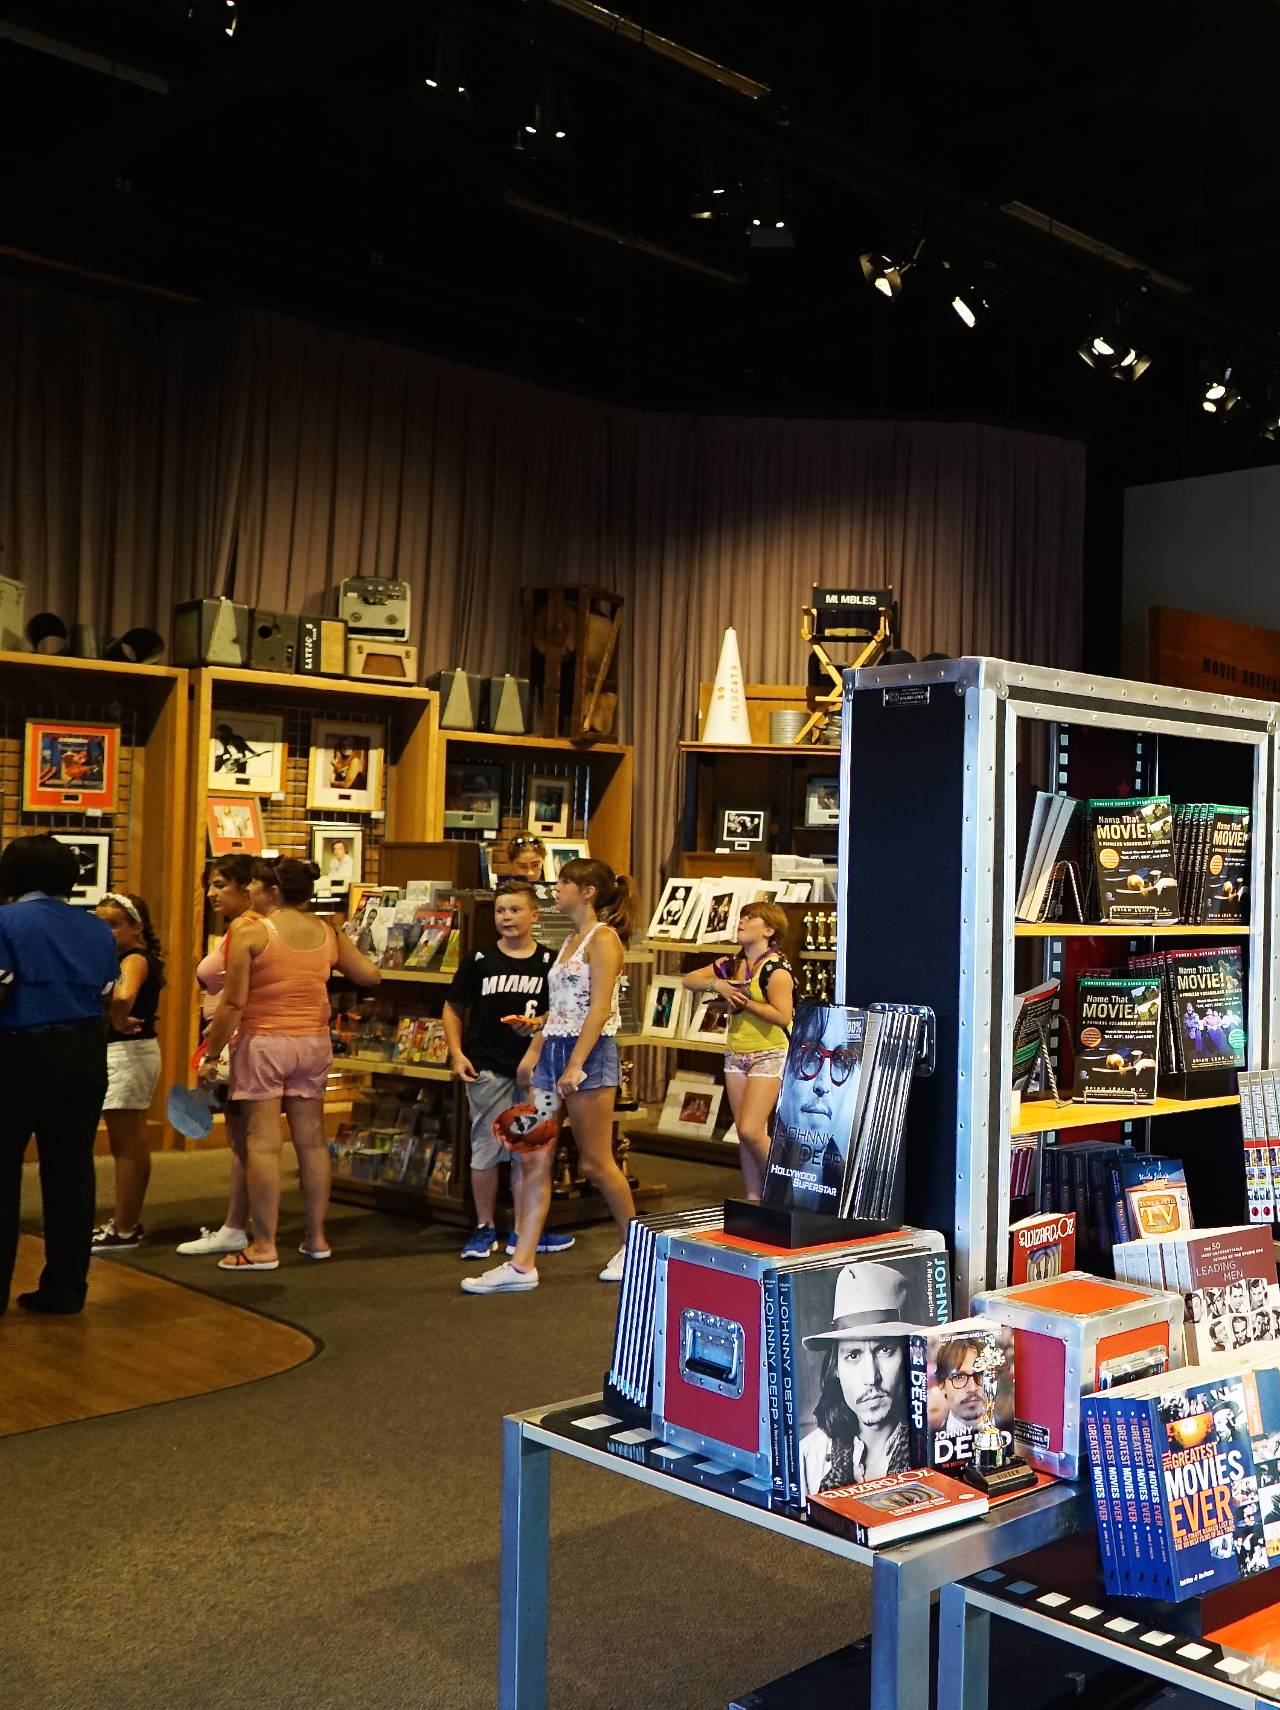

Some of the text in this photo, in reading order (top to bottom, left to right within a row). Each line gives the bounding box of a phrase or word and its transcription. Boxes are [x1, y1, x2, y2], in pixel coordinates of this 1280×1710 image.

[1203, 658, 1236, 682] MOVIE
[1122, 815, 1139, 823] That
[1217, 822, 1241, 831] Name That
[1097, 823, 1152, 839] MOVIE!
[1213, 830, 1247, 846] MOVIE!
[1198, 965, 1214, 973] That
[481, 975, 544, 996] MIAMI
[1177, 973, 1224, 990] MOVIE!
[1082, 1003, 1139, 1018] MOVIE!
[1086, 995, 1128, 1004] Name That
[779, 1125, 834, 1145] JOHNNY
[800, 1144, 842, 1167] DEPP
[771, 1164, 816, 1182] HOLLYWOOD
[793, 1178, 837, 1197] SUPERSTAR
[1140, 1204, 1176, 1226] TV
[1023, 1225, 1057, 1248] WIZARD
[1211, 1242, 1220, 1250] 50
[1196, 1261, 1236, 1276] LEADING
[1223, 1269, 1243, 1281] MEN
[765, 1293, 776, 1366] JOHNNY
[780, 1296, 791, 1371] JOHNNY
[768, 1373, 778, 1420] DEPP
[783, 1377, 793, 1425] DEPP
[911, 1370, 923, 1429] DEPP
[935, 1426, 973, 1441] JOHNNY
[934, 1431, 1012, 1464] DEP
[1161, 1441, 1218, 1471] THE GREATEST
[1088, 1424, 1107, 1521] GREATEST MOVIES EVER
[1103, 1424, 1123, 1521] GREATEST MOVIES EVER
[1117, 1424, 1138, 1522] GREATEST MOVIES EVER
[1131, 1425, 1151, 1524] GREATEST MOVIES EVER
[1142, 1427, 1163, 1526] GREATEST MOVIES EVER
[1164, 1450, 1245, 1503] MOVIES
[836, 1476, 897, 1498] WIZARD
[1169, 1485, 1233, 1538] EVER
